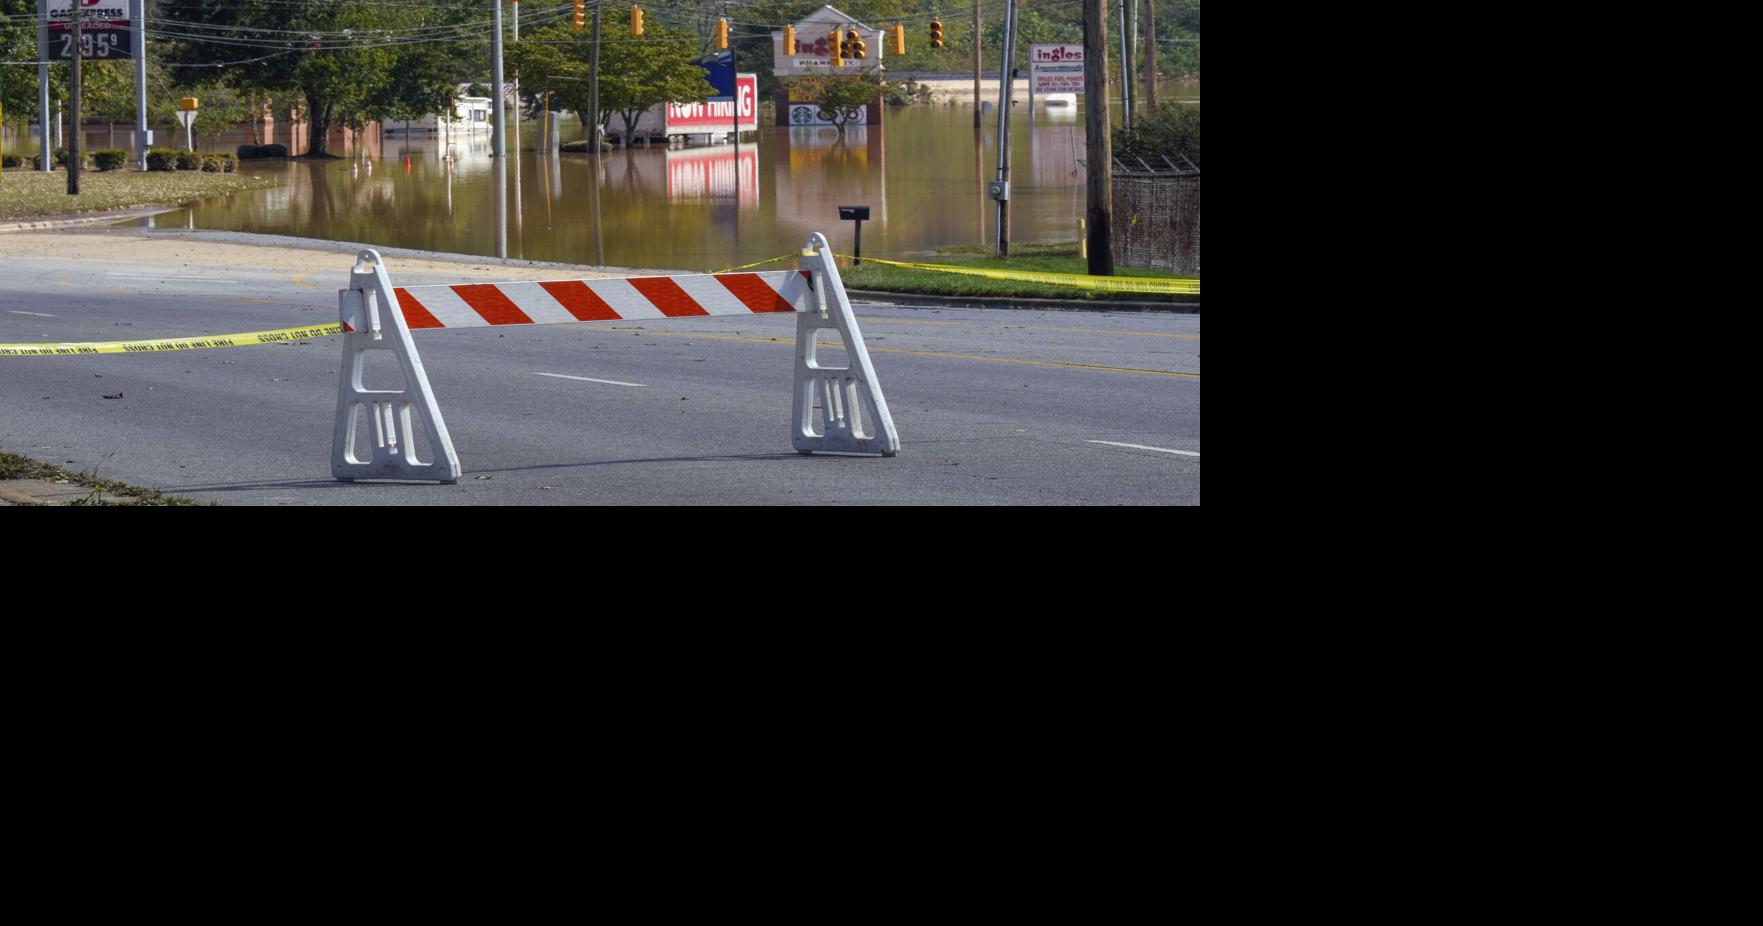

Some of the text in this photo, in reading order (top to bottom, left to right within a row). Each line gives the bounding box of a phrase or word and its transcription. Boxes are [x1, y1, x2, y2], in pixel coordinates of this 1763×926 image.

[1037, 47, 1082, 62] ingles
[257, 332, 288, 342] CROSS
[289, 330, 309, 339] NOT
[309, 328, 323, 337] DO
[122, 344, 153, 352] CROSS
